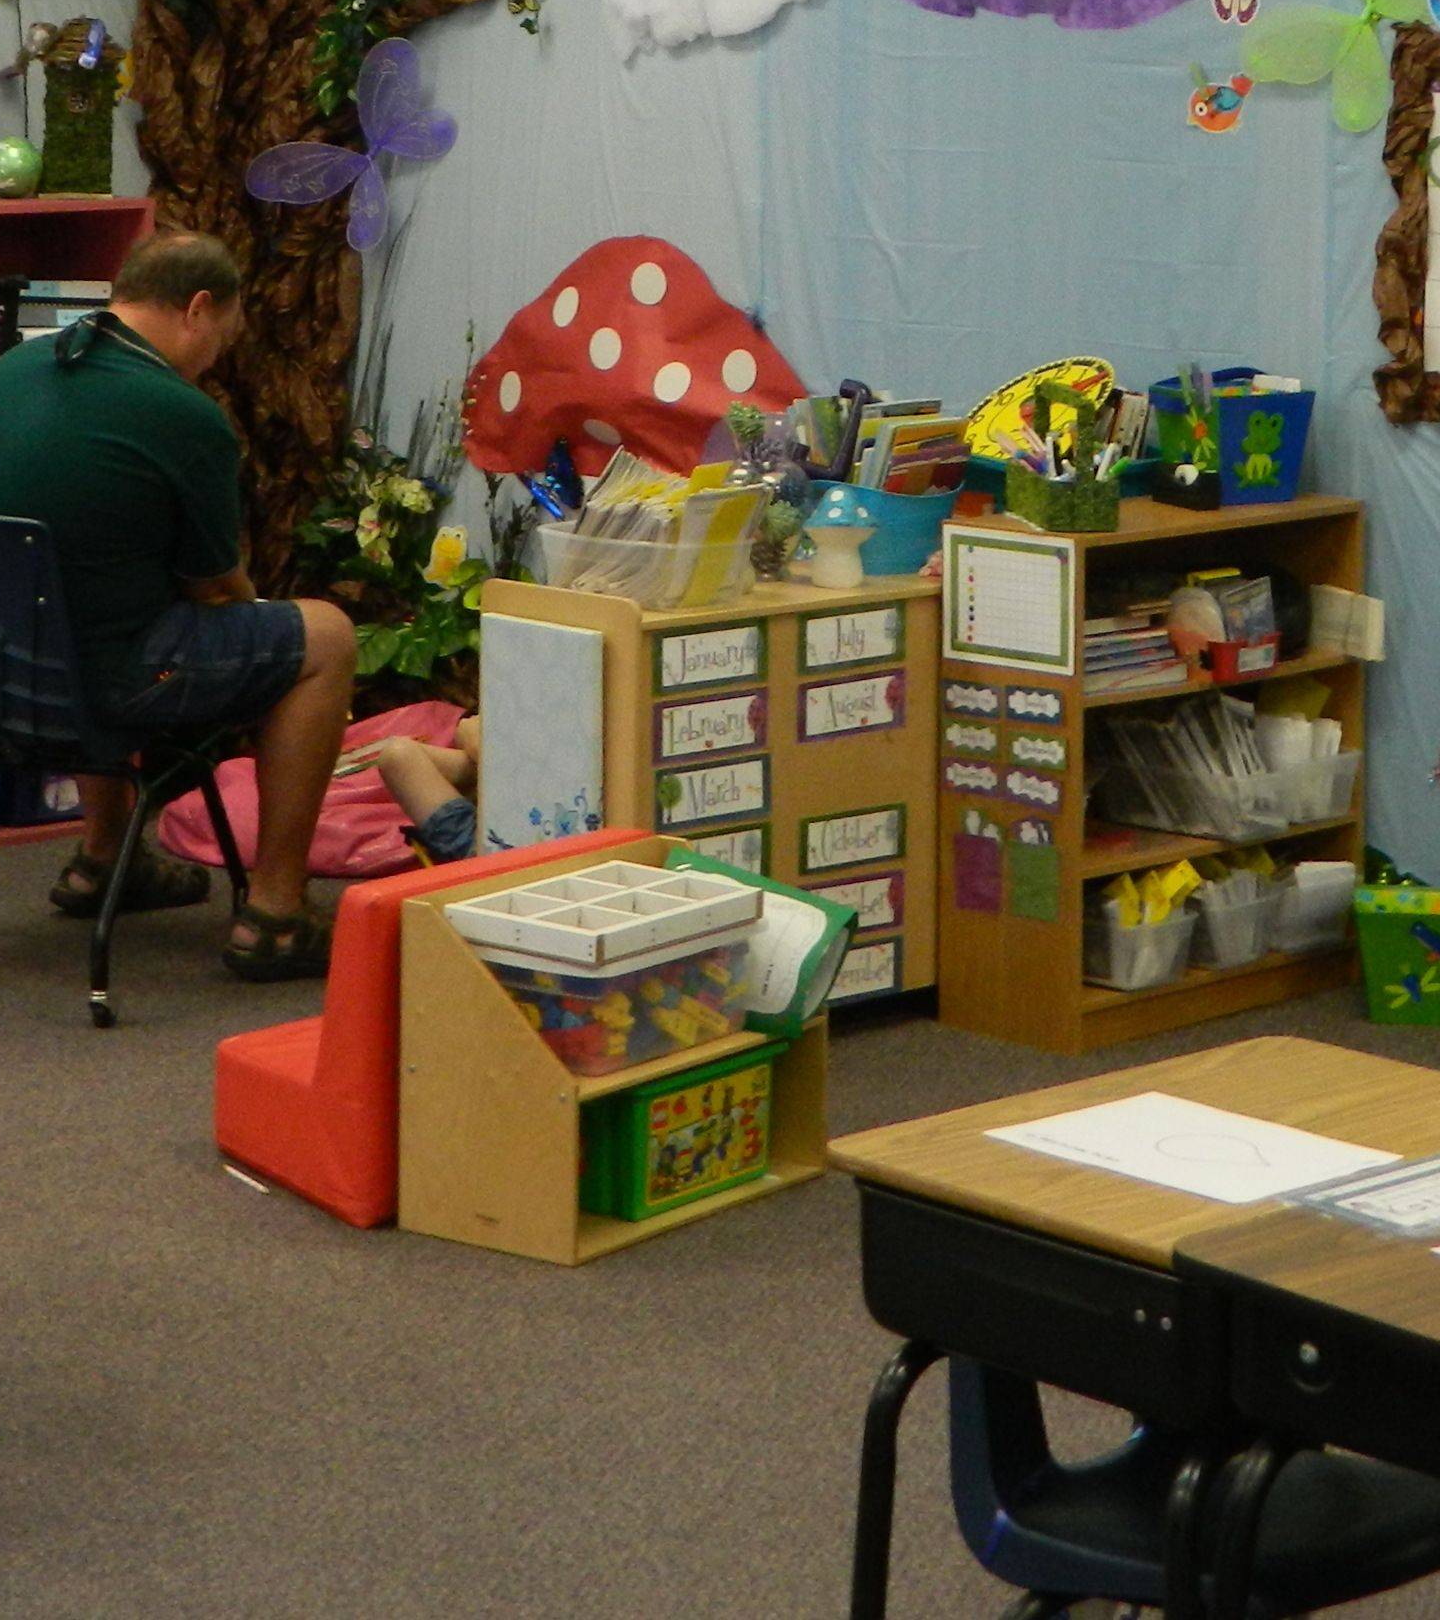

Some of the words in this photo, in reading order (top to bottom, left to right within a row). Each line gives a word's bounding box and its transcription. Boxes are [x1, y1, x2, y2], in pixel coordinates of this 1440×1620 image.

[669, 638, 744, 684] January
[830, 619, 865, 659] July
[663, 709, 745, 754] February
[686, 770, 741, 817] March
